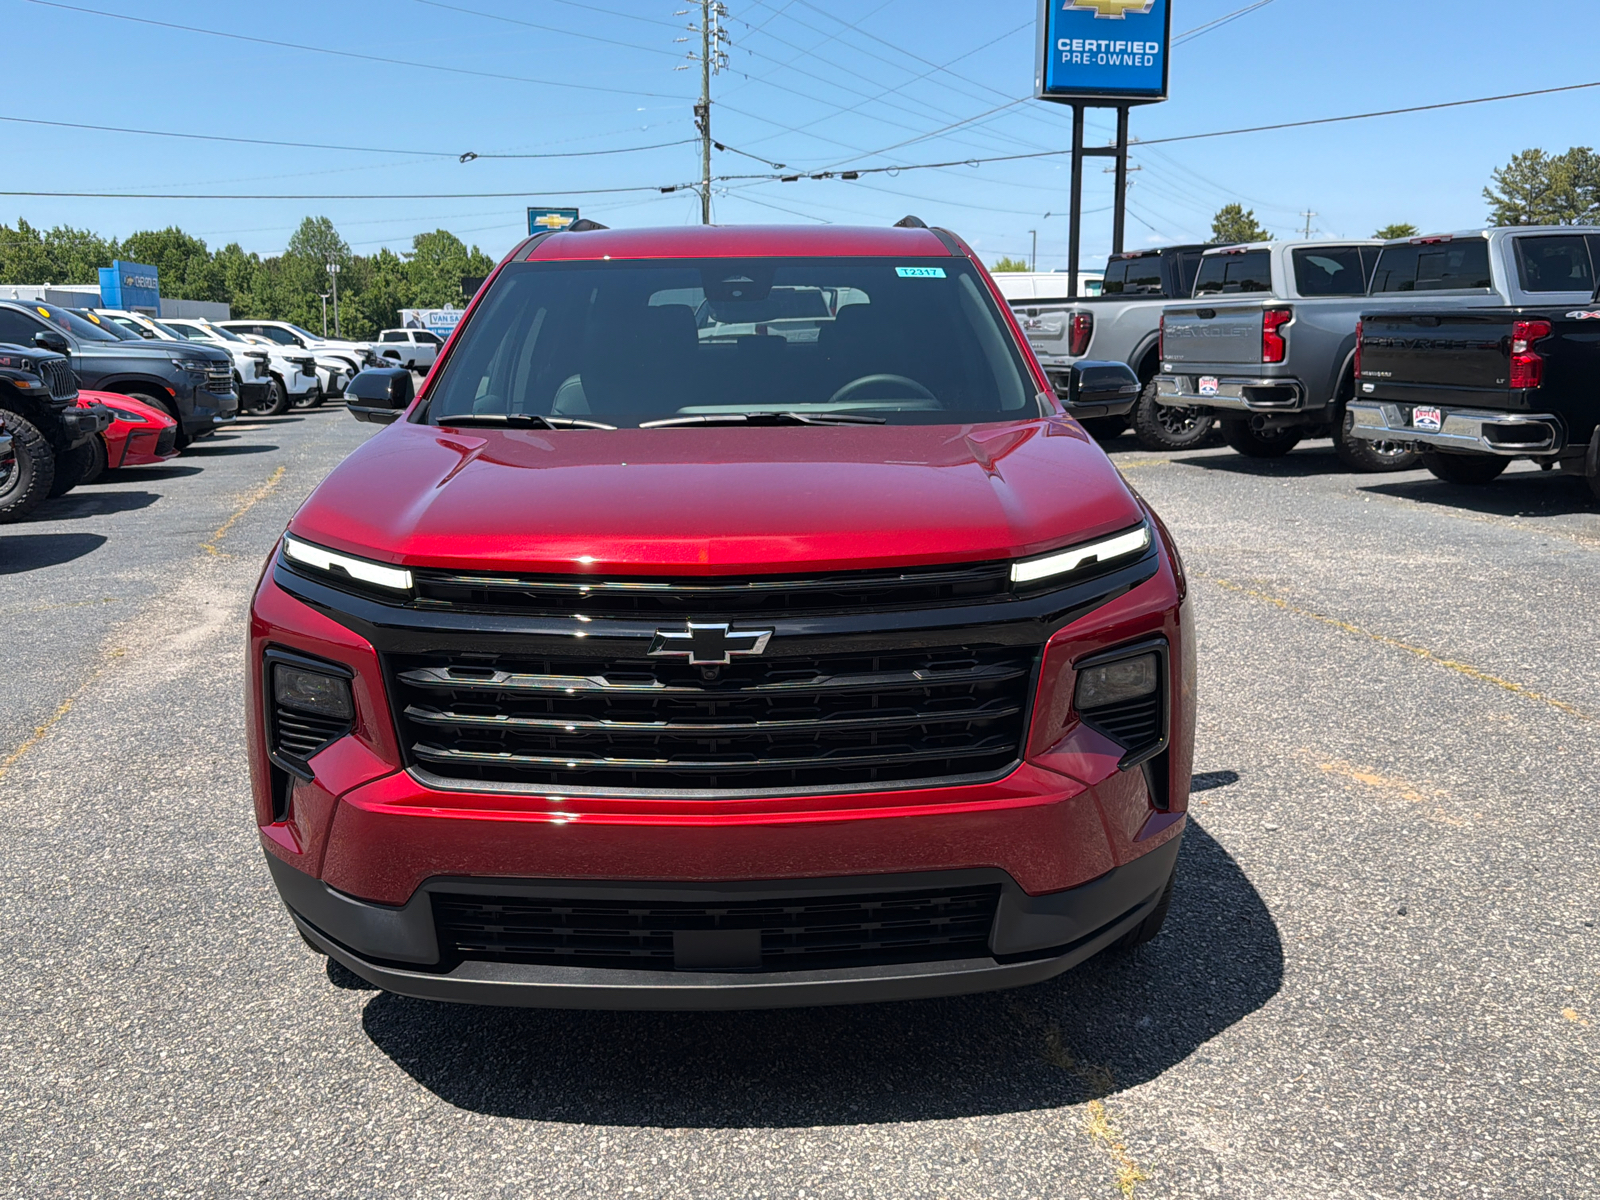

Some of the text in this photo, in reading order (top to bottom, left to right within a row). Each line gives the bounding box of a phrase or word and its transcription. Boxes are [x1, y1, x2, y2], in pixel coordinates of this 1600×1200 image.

[1057, 38, 1159, 54] CERTIFIED
[1061, 52, 1154, 66] PRE-OWNED
[900, 268, 937, 276] T2317
[1165, 324, 1255, 338] CHEVROLET
